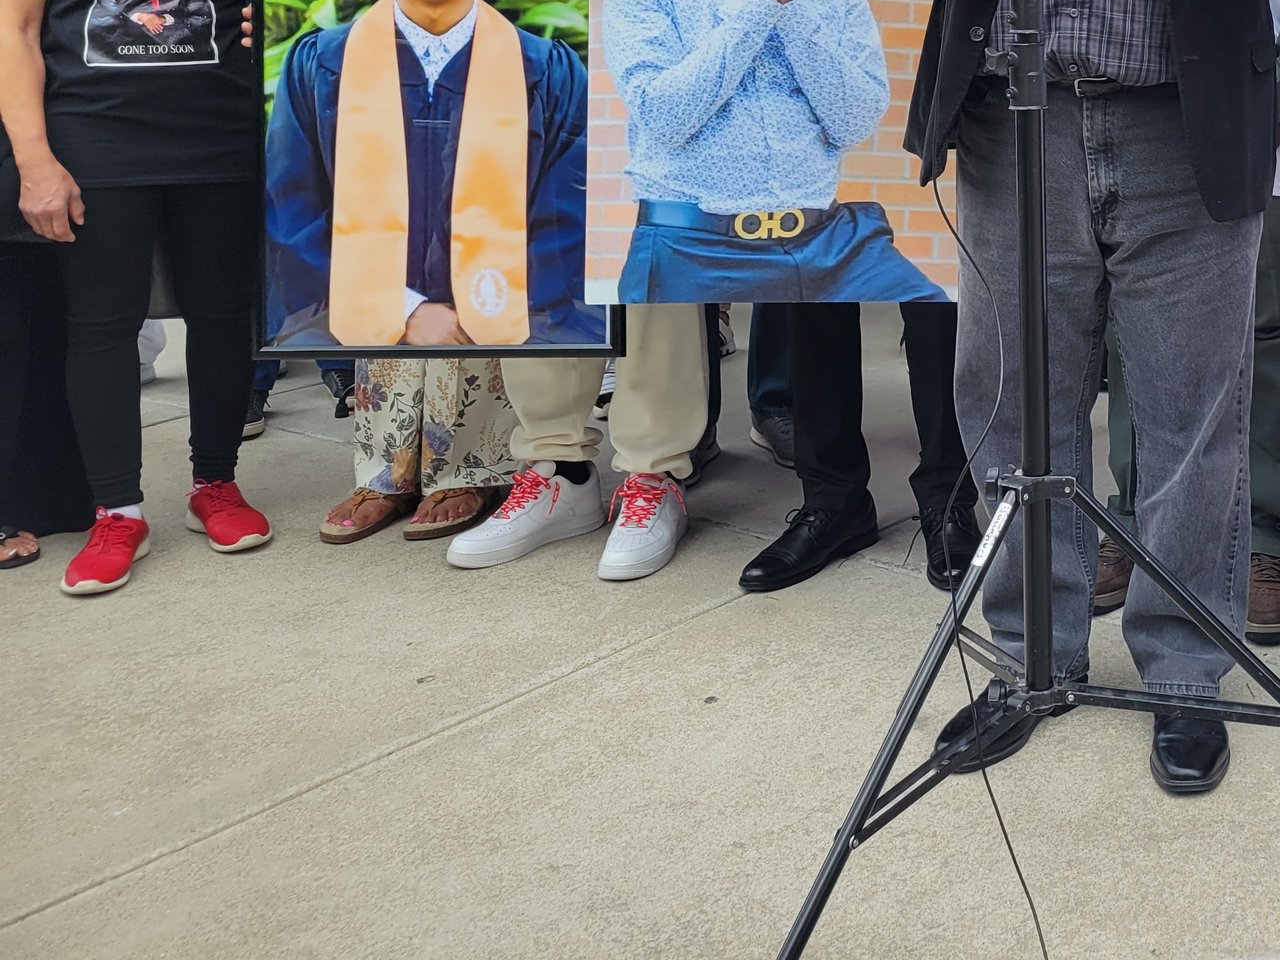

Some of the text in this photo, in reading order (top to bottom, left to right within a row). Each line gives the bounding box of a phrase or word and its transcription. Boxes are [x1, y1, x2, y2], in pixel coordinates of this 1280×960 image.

[118, 43, 195, 55] GONE TOO SOON
